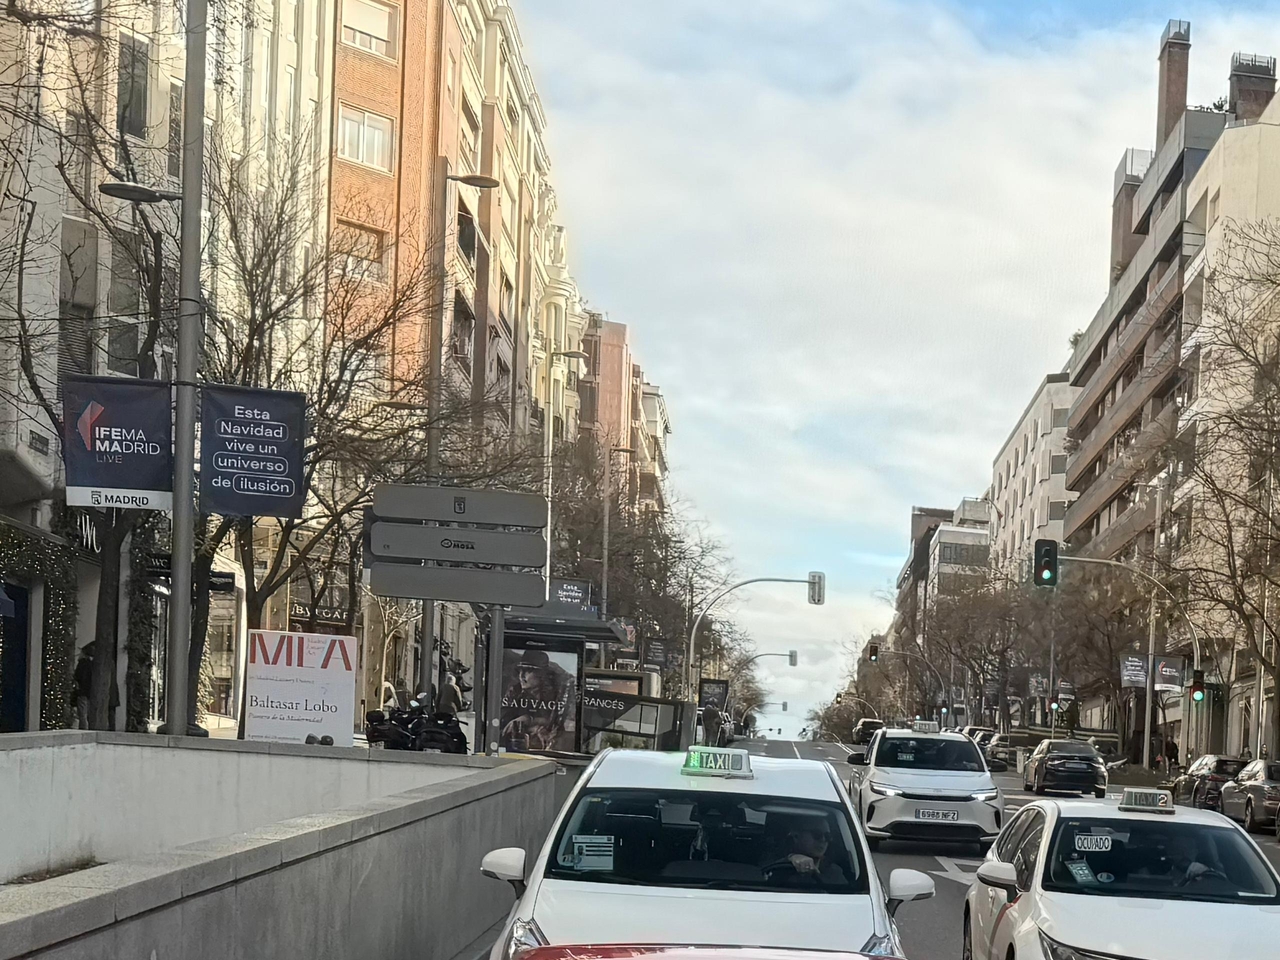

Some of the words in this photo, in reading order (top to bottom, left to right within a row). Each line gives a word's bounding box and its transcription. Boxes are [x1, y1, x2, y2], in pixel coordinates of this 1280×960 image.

[235, 405, 270, 420] Esta
[95, 426, 146, 441] IFEMA
[220, 421, 283, 438] Navidad
[95, 440, 161, 455] MADRID
[225, 439, 255, 453] vive
[259, 444, 277, 454] un
[96, 453, 123, 464] LIVE
[218, 457, 284, 473] universo
[212, 476, 231, 488] de
[240, 477, 290, 493] ilusión
[105, 494, 149, 507] MADRID
[249, 694, 300, 711] Baltasar
[304, 698, 338, 714] Lobo
[502, 697, 565, 710] SAUVAGE
[583, 696, 625, 710] RANCÉS
[701, 753, 729, 769] TAXI
[1158, 794, 1167, 806] 2
[1077, 837, 1110, 850] OCUPADO
